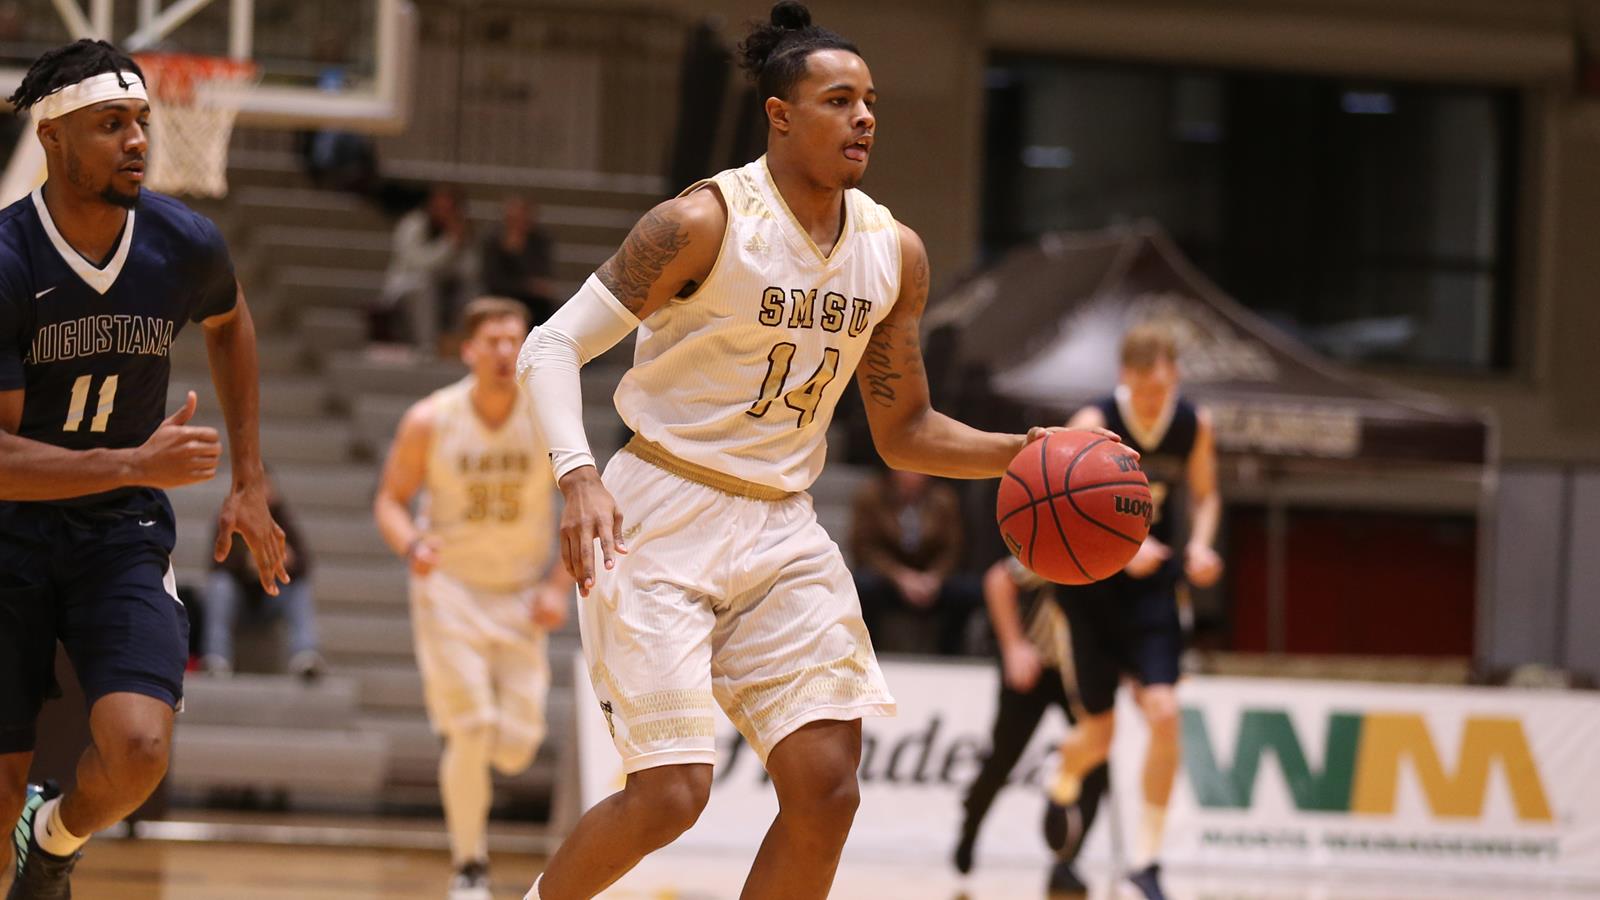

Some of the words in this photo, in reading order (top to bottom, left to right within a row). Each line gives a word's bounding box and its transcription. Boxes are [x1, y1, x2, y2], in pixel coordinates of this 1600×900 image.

[24, 314, 175, 365] AUGUSTANA
[759, 286, 872, 338] SMSU
[62, 374, 119, 433] 11
[745, 341, 840, 429] 14
[1180, 708, 1554, 823] WM
